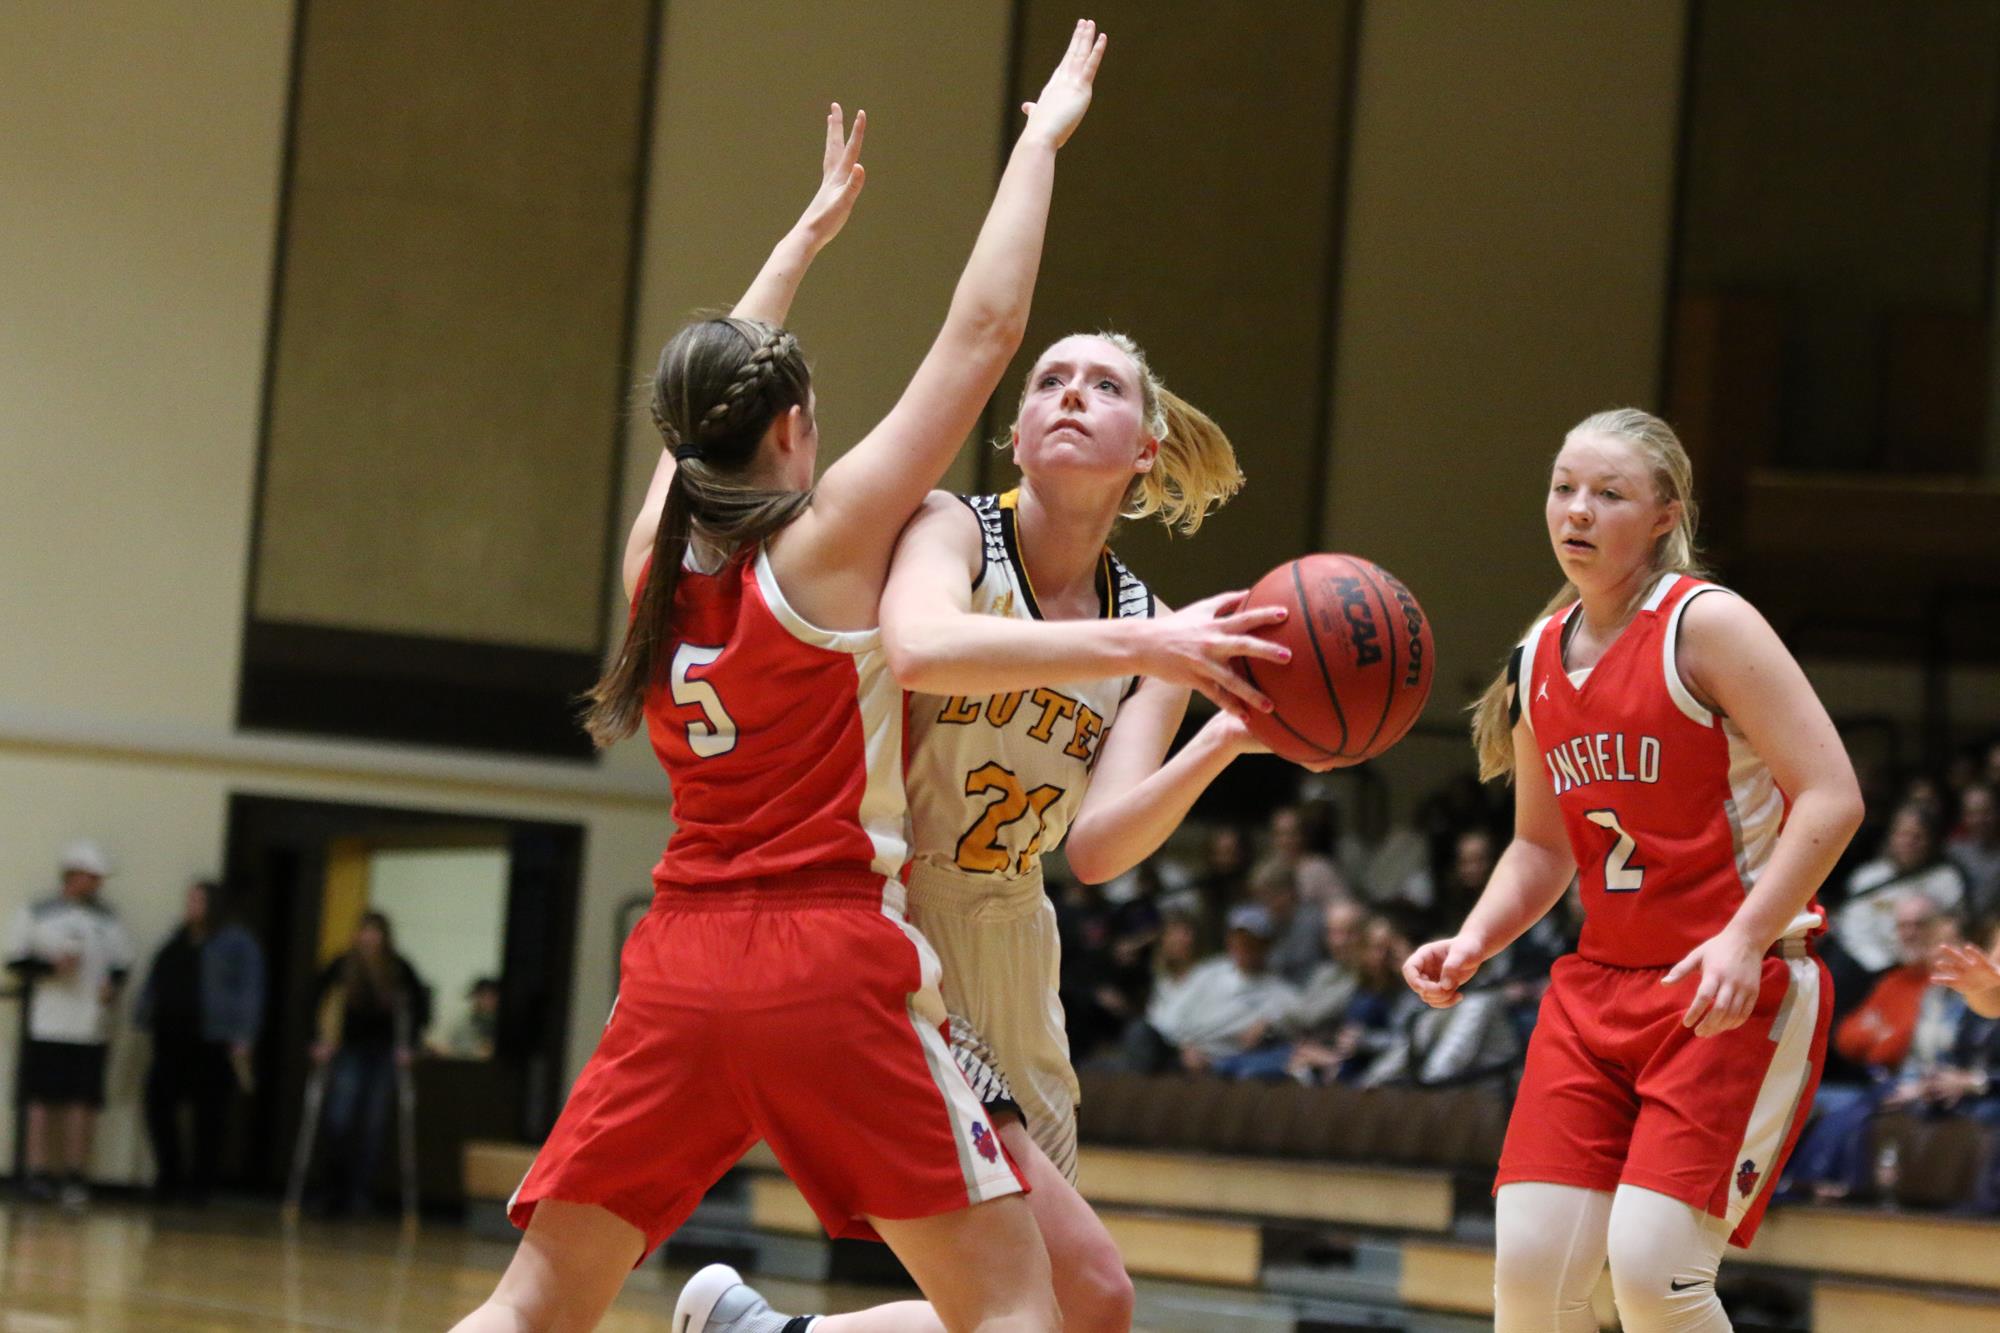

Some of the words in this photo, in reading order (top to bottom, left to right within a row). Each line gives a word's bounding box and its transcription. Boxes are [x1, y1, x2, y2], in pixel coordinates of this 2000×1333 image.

[1330, 577, 1382, 667] NCAA
[671, 641, 738, 759] 5
[936, 687, 1111, 776] LUTE
[1584, 808, 1645, 892] 2
